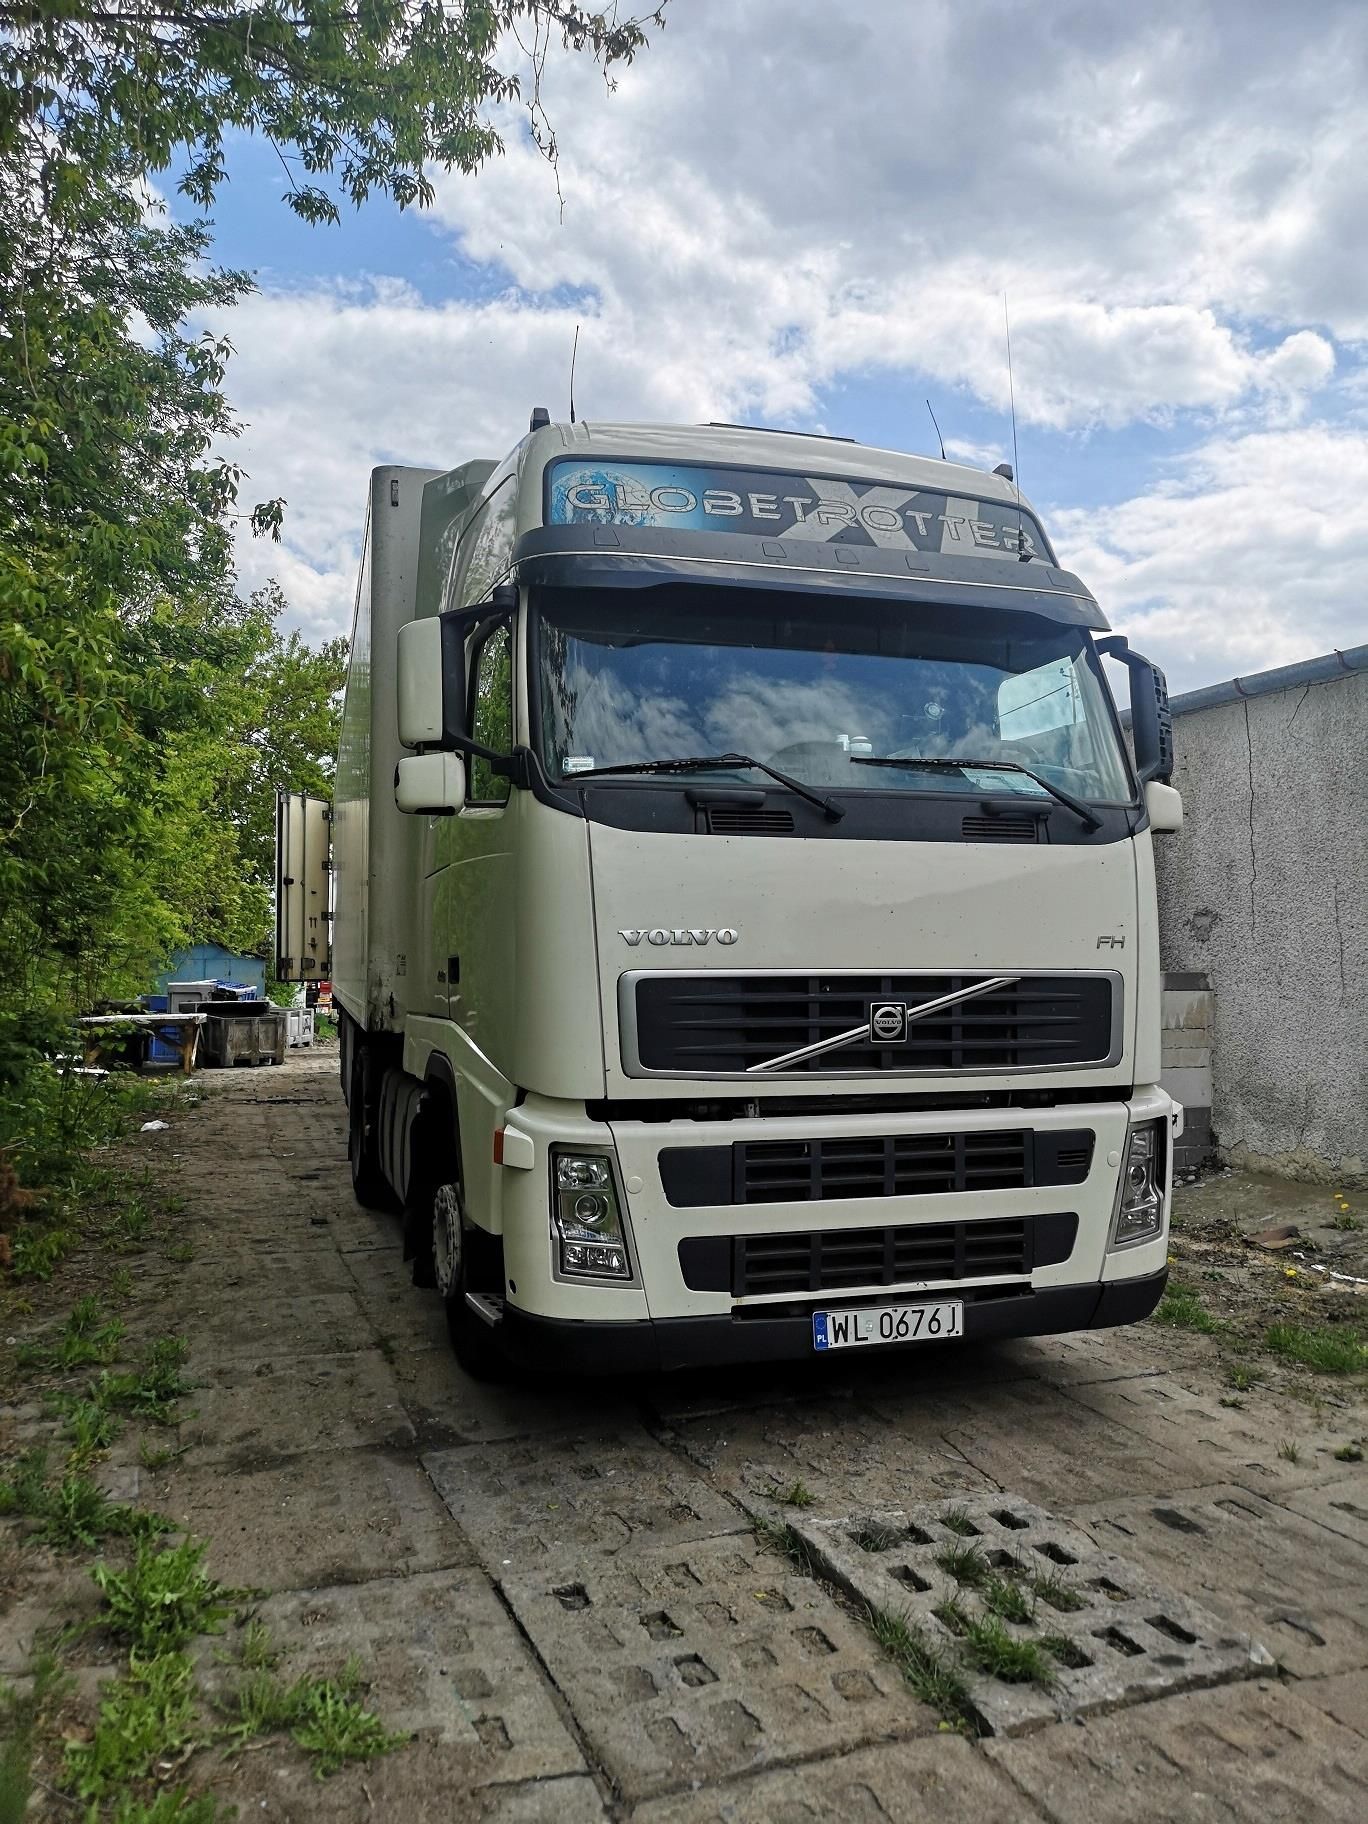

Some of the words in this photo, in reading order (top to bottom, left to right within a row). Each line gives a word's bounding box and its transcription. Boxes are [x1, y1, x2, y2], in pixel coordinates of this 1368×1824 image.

[566, 483, 1039, 556] GLOBETROTTER
[618, 928, 739, 946] VOLVO
[1096, 935, 1126, 949] FH
[832, 1314, 868, 1343] WL
[879, 1306, 956, 1339] 0676J
[817, 1335, 828, 1343] PL
